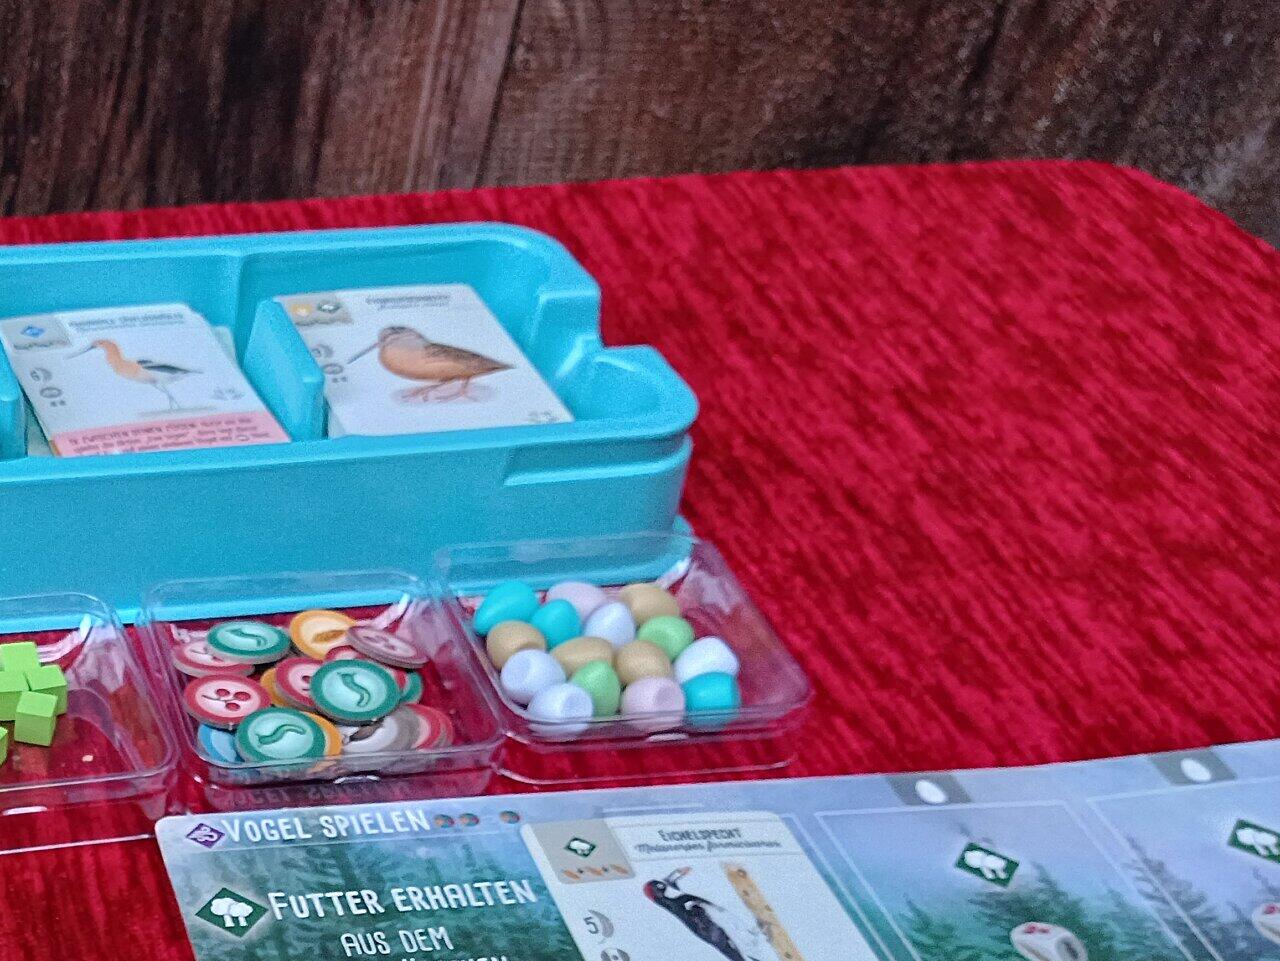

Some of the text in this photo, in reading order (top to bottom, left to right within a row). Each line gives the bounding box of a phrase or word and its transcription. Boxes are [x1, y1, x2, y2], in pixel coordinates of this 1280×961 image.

[222, 808, 431, 843] VOGEL SPIELEN
[267, 878, 538, 921] FUTTER ERHALTEN
[340, 926, 454, 957] AUS DEM
[583, 915, 600, 936] 5
